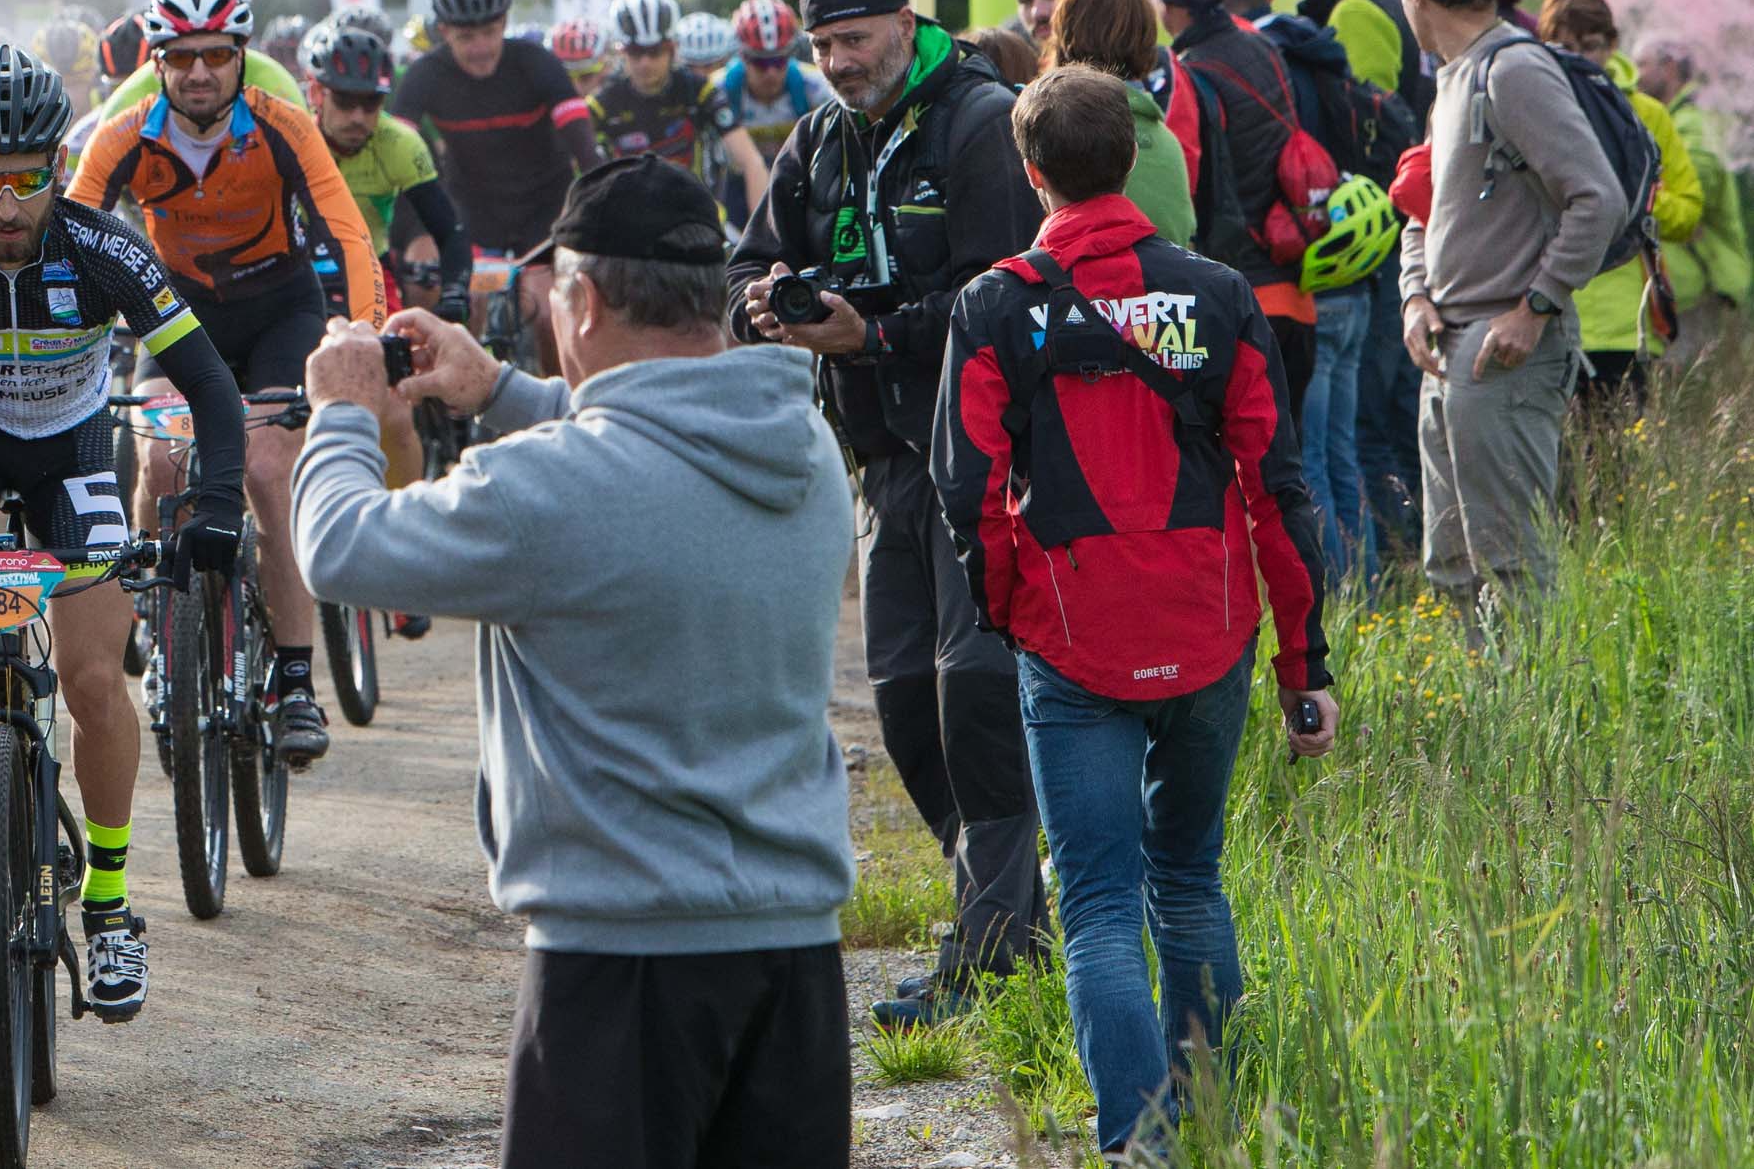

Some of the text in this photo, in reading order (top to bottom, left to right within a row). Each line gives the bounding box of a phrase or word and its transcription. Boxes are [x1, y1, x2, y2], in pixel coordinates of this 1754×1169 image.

[100, 231, 148, 273] MEUSE
[140, 264, 164, 291] 55
[1162, 348, 1204, 370] Lans
[40, 864, 54, 906] LEON
